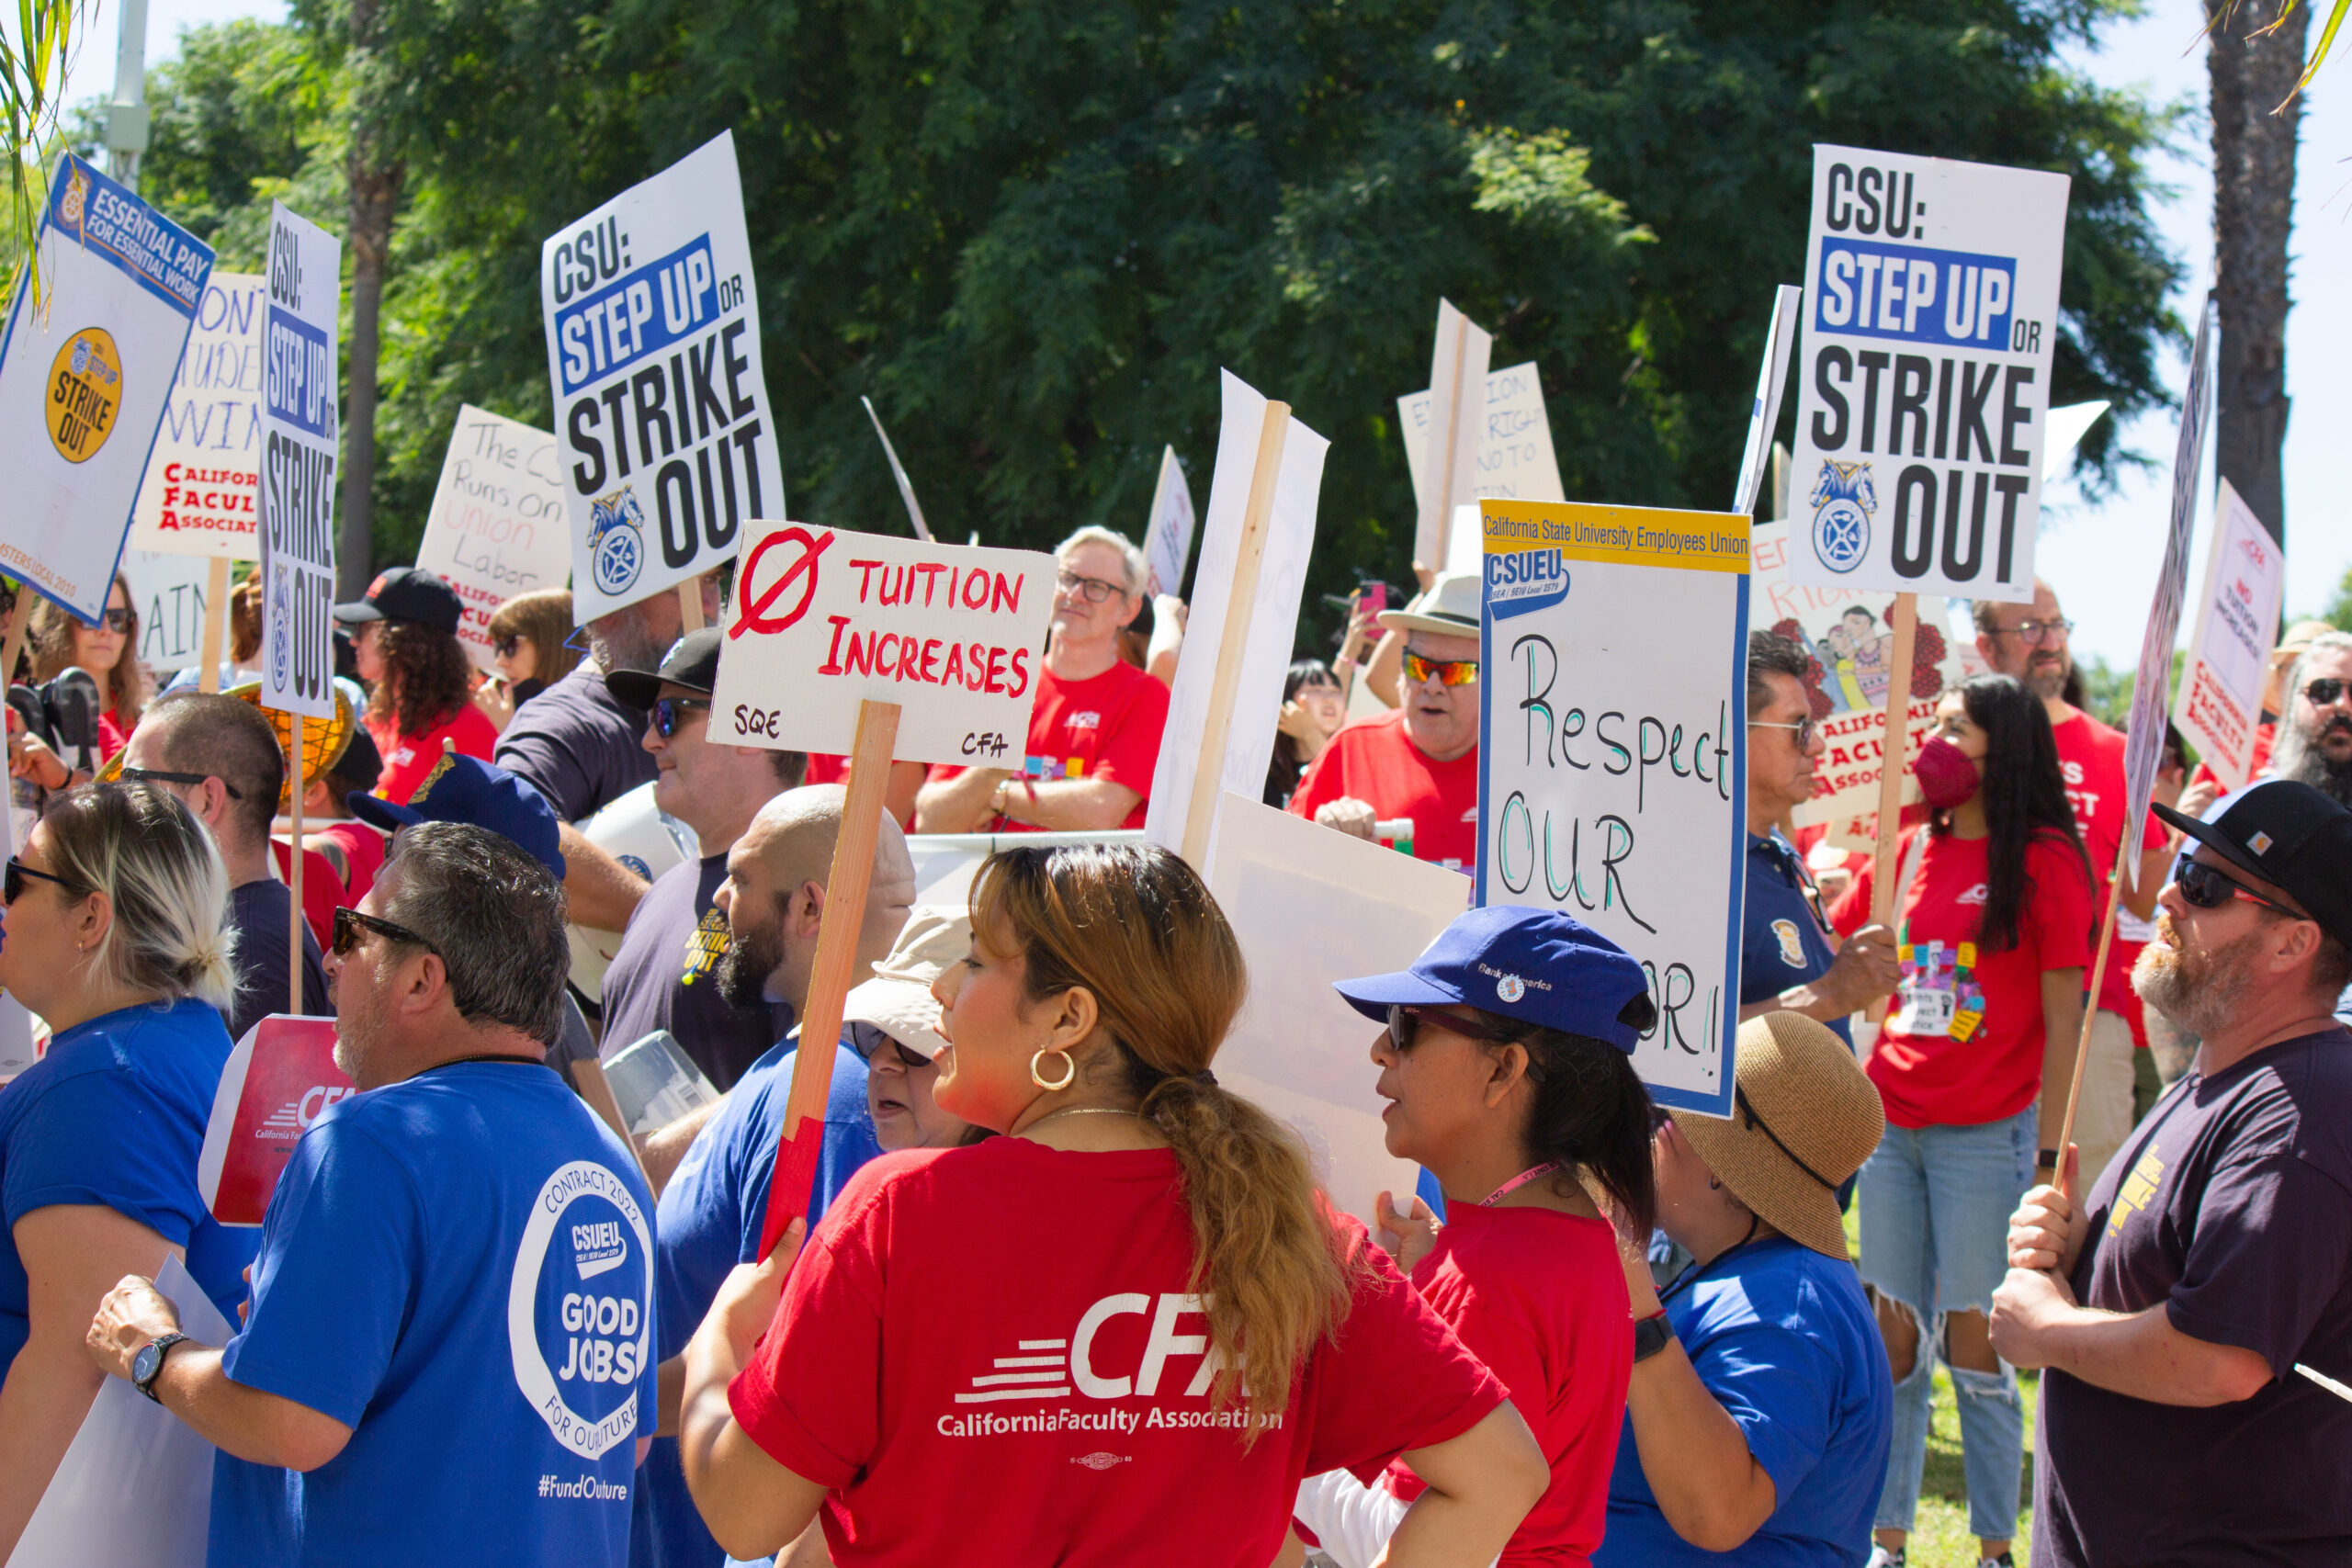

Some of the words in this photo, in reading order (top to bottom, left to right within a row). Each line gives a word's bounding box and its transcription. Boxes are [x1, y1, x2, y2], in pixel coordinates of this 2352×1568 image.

[93, 187, 177, 265] ESSENTIAL
[173, 245, 209, 282] PAY
[1826, 163, 1927, 240] CSU:
[86, 215, 114, 243] FOR
[108, 228, 168, 281] ESSENTIAL
[164, 265, 200, 304] WORK
[271, 220, 302, 311] CSU:
[554, 214, 632, 305] CSU:
[560, 278, 653, 386] STEP
[658, 247, 713, 336] UP
[719, 274, 744, 313] OR
[1822, 250, 1937, 333] STEP
[1944, 264, 2010, 340] UP
[2013, 319, 2041, 354] OR
[53, 370, 112, 433] STRIKE
[270, 321, 304, 416] STEP
[305, 339, 328, 427] UP
[325, 401, 336, 442] OR
[567, 316, 756, 496] STRIKE
[1811, 344, 2035, 468] STRIKE
[57, 412, 91, 456] OUT
[163, 487, 255, 513] FACUL
[267, 429, 334, 570] STRIKE
[655, 417, 764, 570] OUT
[1484, 514, 1539, 538] California
[1542, 519, 1571, 542] State
[1575, 521, 1633, 550] University
[1637, 525, 1706, 555] Employees
[1710, 531, 1748, 555] Union
[1891, 464, 2030, 584] OUT
[849, 558, 1024, 614] TUITION
[1489, 548, 1562, 585] CSUEU
[294, 567, 333, 701] OUT
[818, 615, 1029, 698] INCREASES
[961, 732, 1009, 758] CFA
[1511, 634, 1730, 814] Respect
[1498, 791, 1657, 934] OUR
[684, 930, 729, 953] STRIK
[254, 1129, 289, 1140] California
[545, 1169, 605, 1214] CONTRACT
[609, 1179, 639, 1226] 2022
[572, 1221, 619, 1251] CSUEU
[561, 1292, 639, 1337] GOOD
[559, 1337, 637, 1385] JOBS
[545, 1394, 571, 1438] FOR
